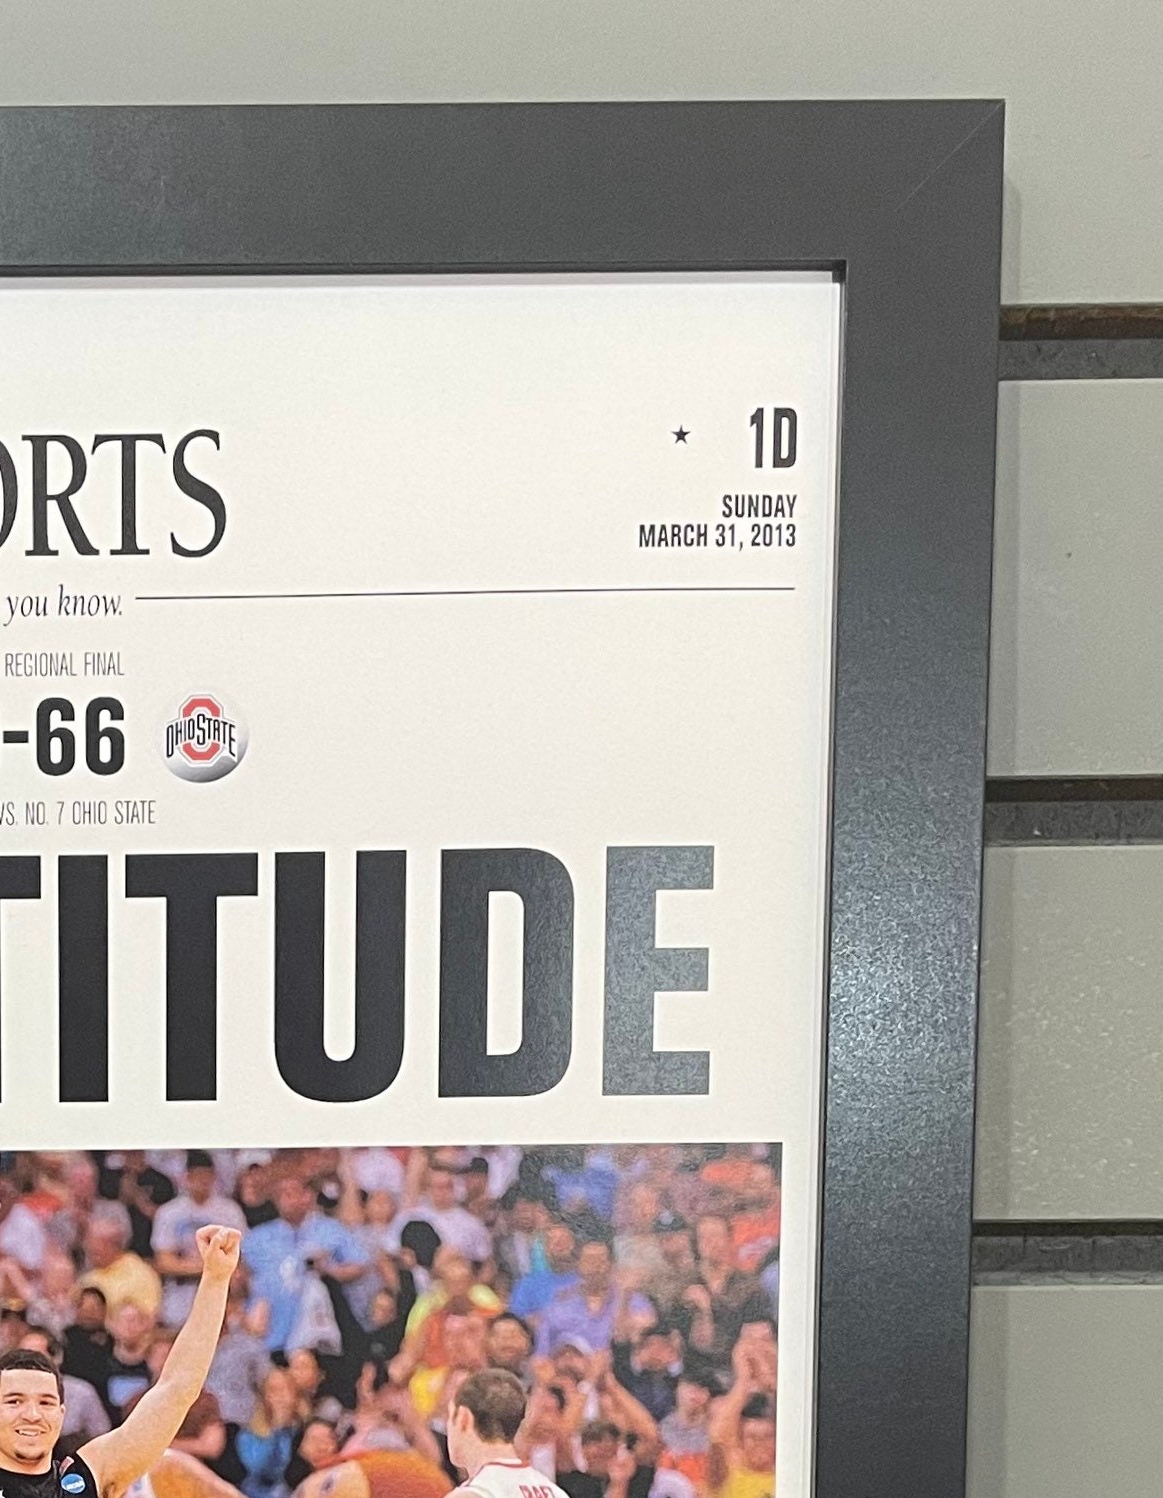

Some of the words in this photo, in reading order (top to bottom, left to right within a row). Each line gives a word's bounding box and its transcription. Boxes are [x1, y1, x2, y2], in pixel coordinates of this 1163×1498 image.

[749, 406, 798, 469] 1D
[722, 494, 798, 519] SUNDAY
[639, 523, 708, 548] MARCH
[715, 523, 744, 552] 31,
[750, 523, 796, 548] 2013
[3, 595, 48, 627] you
[58, 584, 122, 617] know.
[5, 652, 78, 677] REGIONAL
[84, 651, 125, 677] FINAL
[25, 801, 49, 826] NO.
[56, 801, 65, 825] 7
[72, 800, 108, 825] OHIO
[114, 800, 156, 825] STATE
